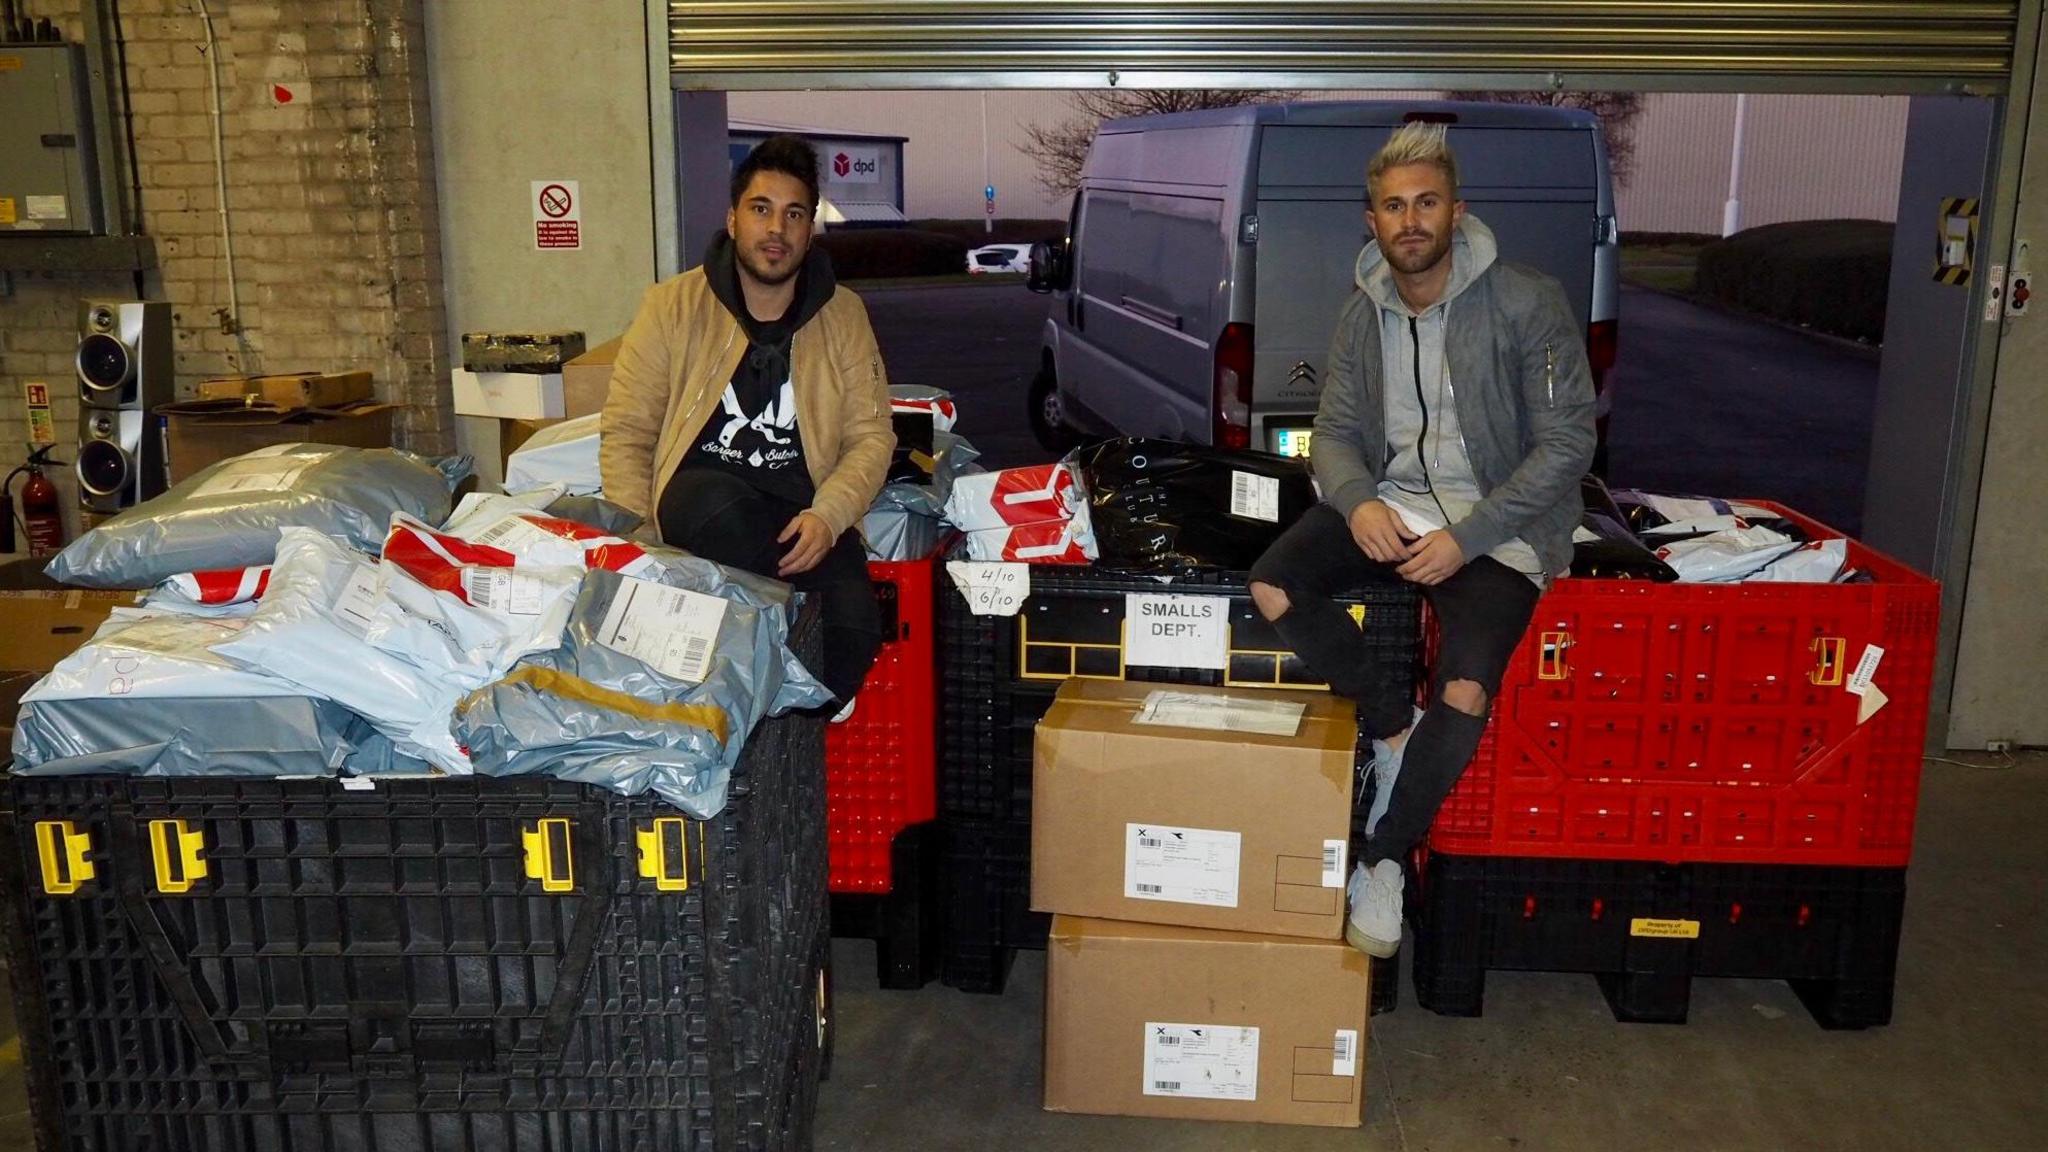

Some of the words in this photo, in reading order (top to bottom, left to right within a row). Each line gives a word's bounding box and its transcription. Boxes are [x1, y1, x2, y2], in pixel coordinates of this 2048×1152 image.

[853, 158, 875, 175] dpd
[981, 567, 1015, 585] 4/10
[979, 586, 1013, 609] 6/10
[1141, 602, 1213, 619] SMALLS
[1151, 622, 1201, 639] DEPT.
